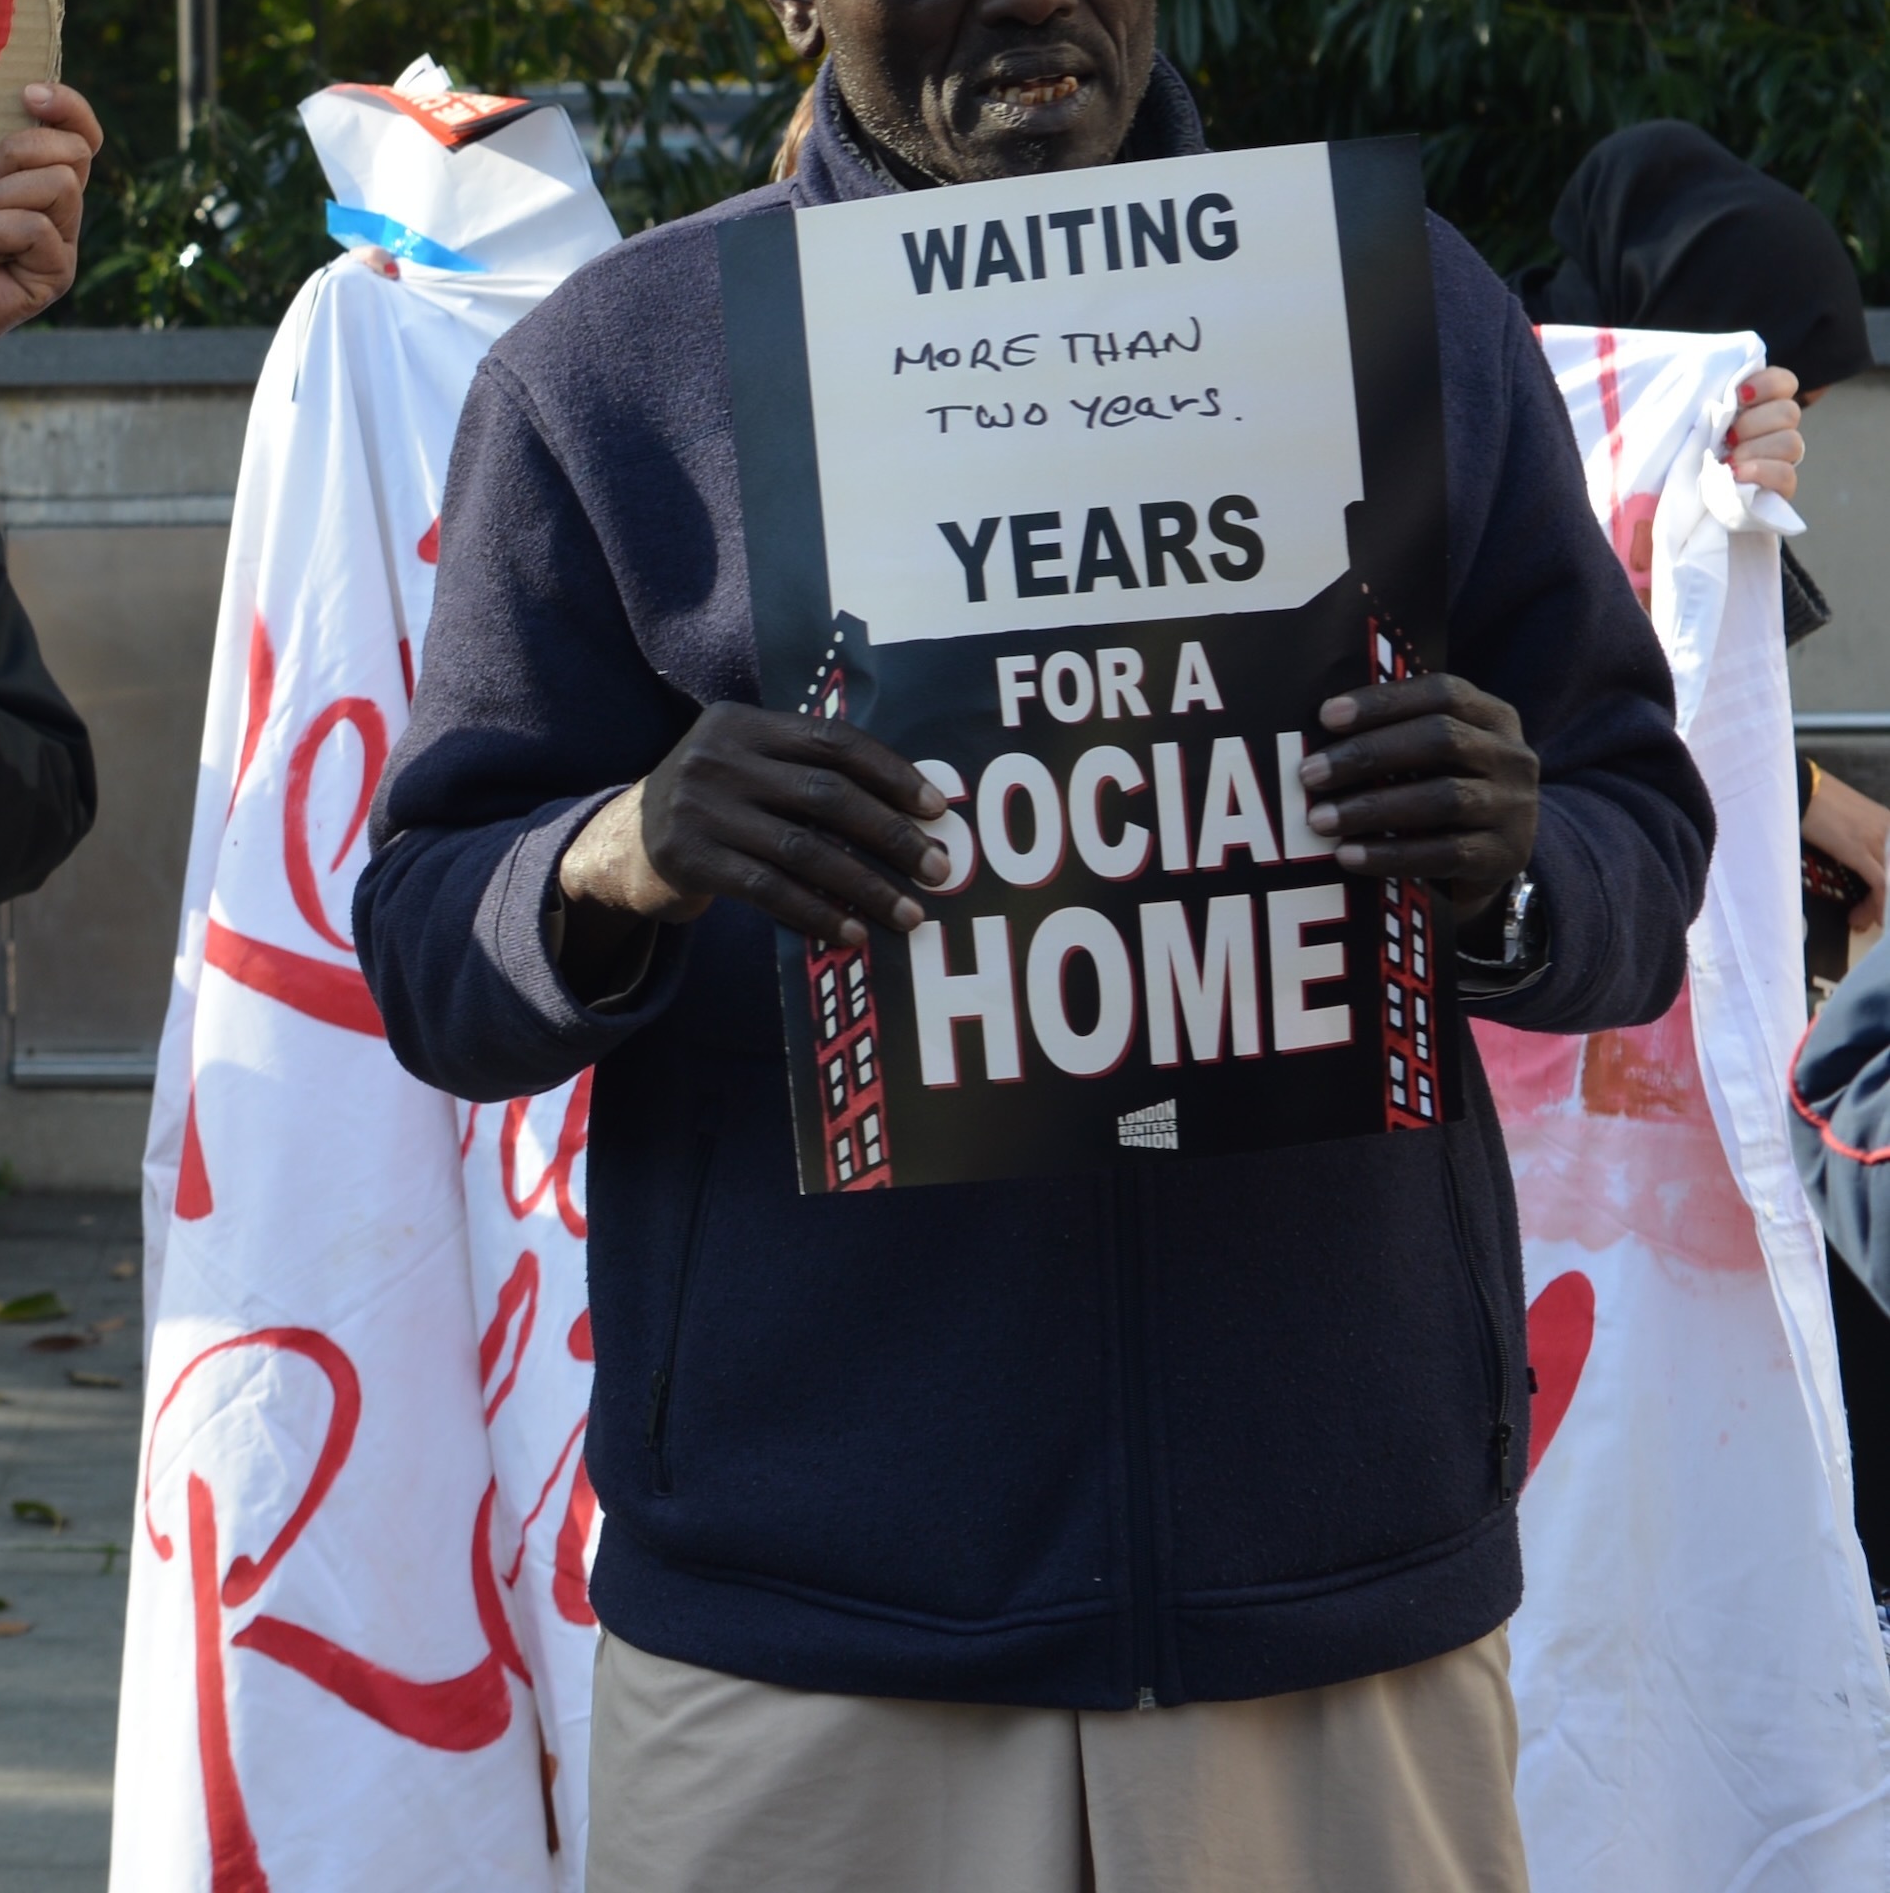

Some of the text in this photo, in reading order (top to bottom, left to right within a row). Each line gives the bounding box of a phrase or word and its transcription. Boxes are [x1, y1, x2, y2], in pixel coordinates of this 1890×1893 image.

[902, 191, 1240, 296] WAITING
[893, 315, 1203, 375] MORE THAN
[925, 401, 1049, 434] TWO
[937, 493, 1266, 604] YEARS
[996, 640, 1225, 728] FOR A
[911, 730, 1343, 896] SOCIAL
[908, 883, 1353, 1089] HOME
